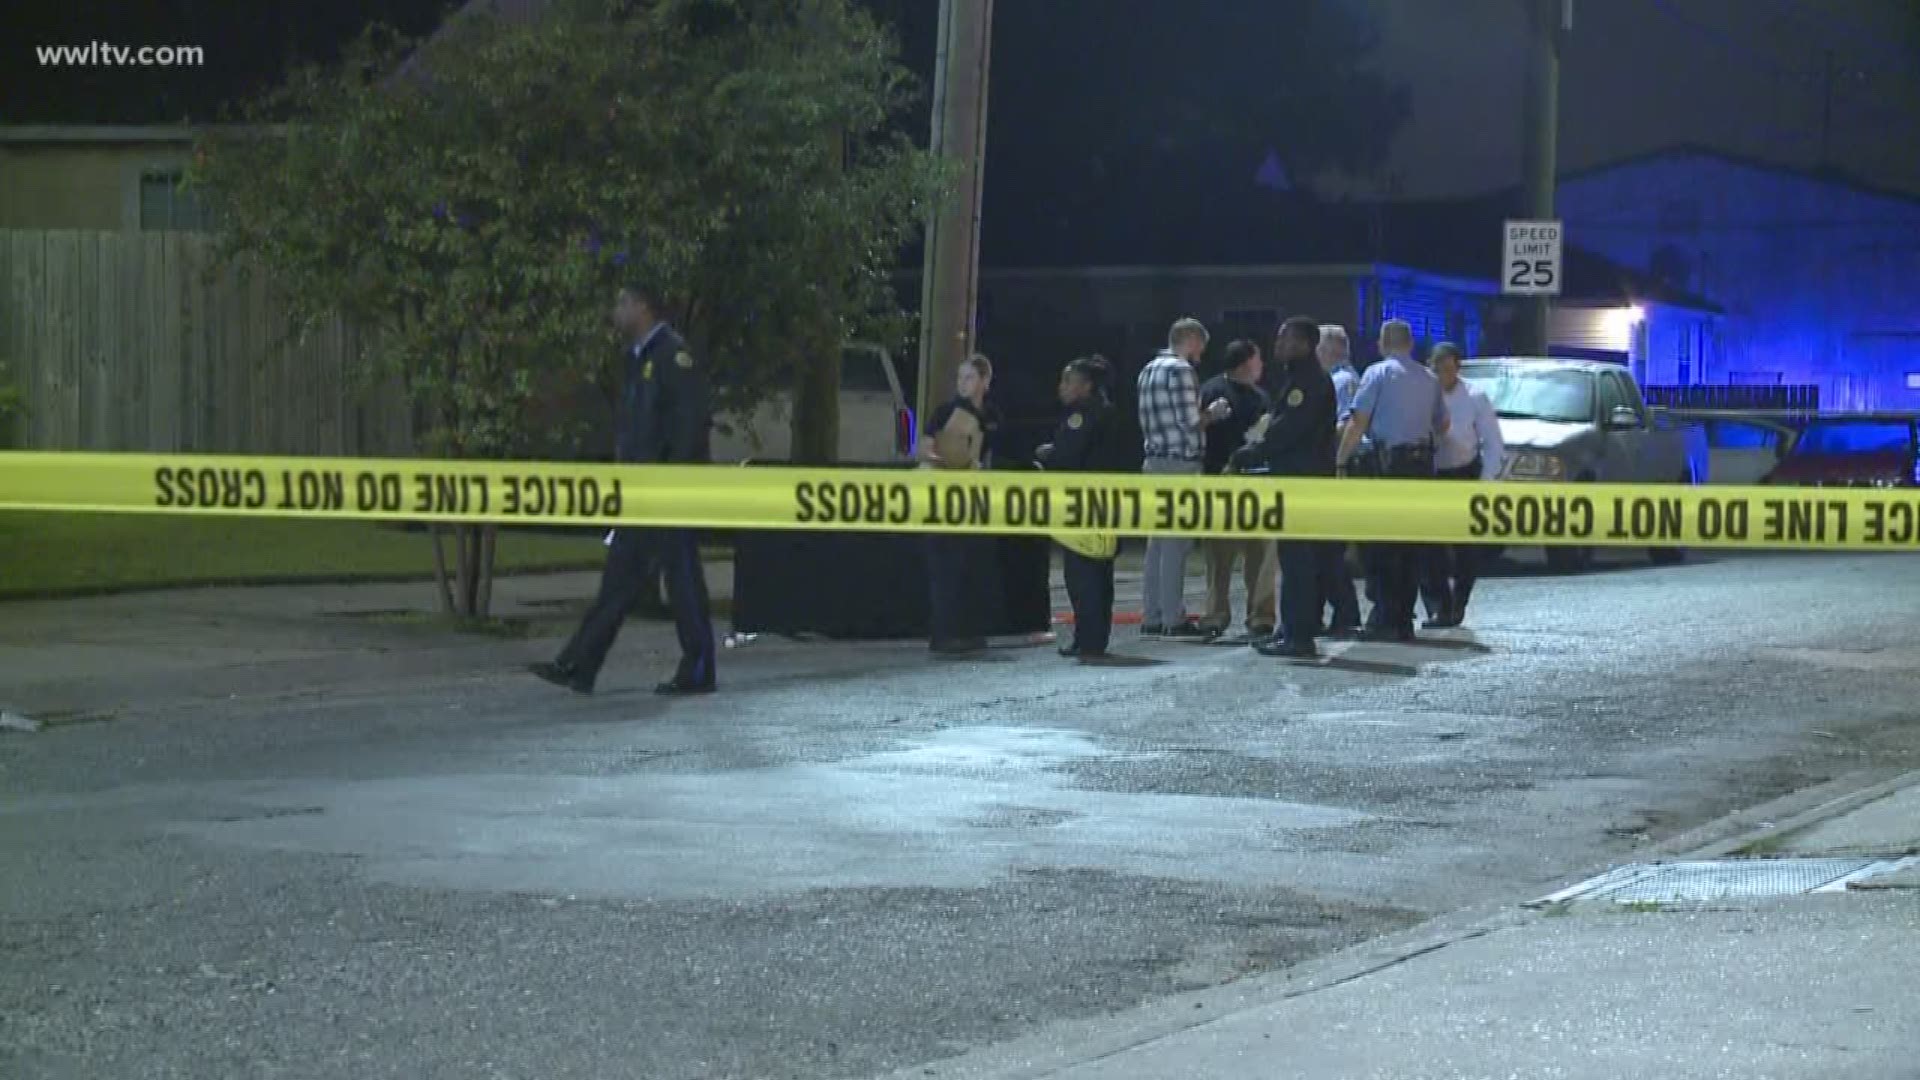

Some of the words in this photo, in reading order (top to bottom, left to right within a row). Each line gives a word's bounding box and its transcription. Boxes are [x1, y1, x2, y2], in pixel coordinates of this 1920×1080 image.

[1509, 227, 1558, 241] SPEED
[1514, 243, 1551, 256] LIMIT
[1510, 260, 1553, 287] 25
[155, 467, 266, 508] CROSS
[276, 471, 344, 510] NOT
[356, 472, 402, 512] DO
[414, 474, 489, 514] LINE
[502, 476, 622, 517] POLICE
[796, 481, 910, 523] CROSS
[922, 484, 990, 525] NOT
[1005, 486, 1050, 526] DO
[1063, 487, 1141, 529] LINE
[1155, 489, 1284, 532] POLICE
[1469, 494, 1594, 538] CROSS
[1606, 497, 1682, 539] NOT
[1697, 499, 1748, 540] DO
[1763, 500, 1848, 542] LINE
